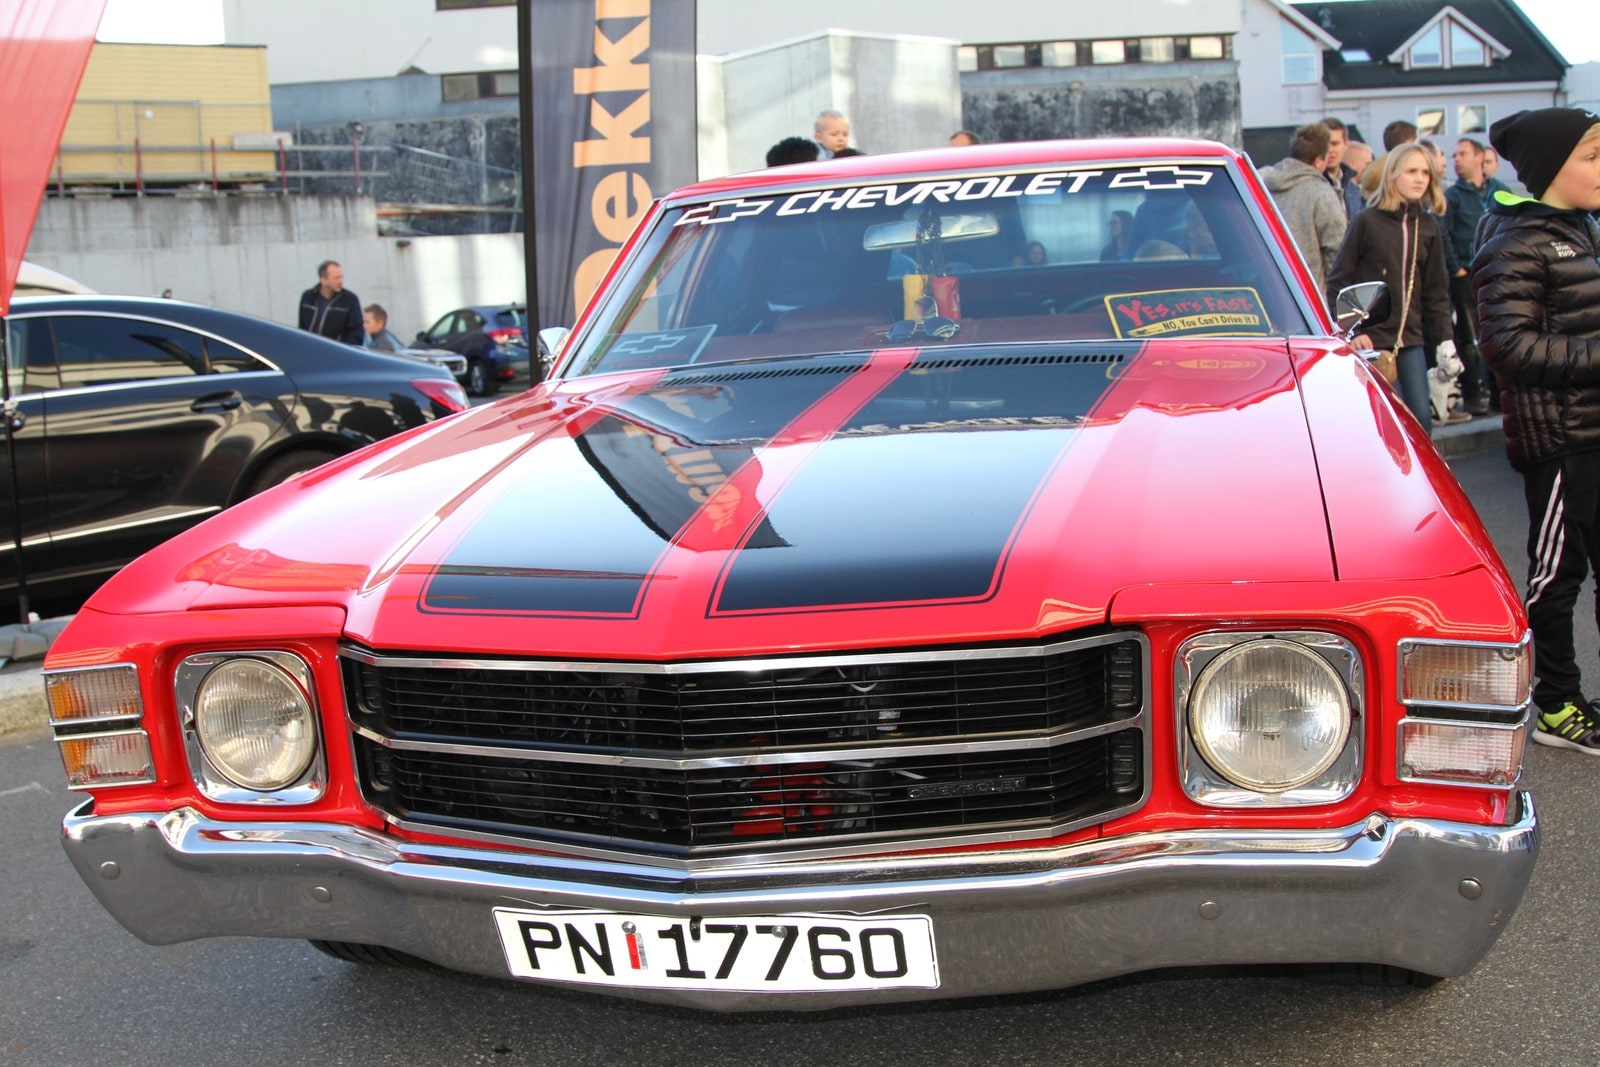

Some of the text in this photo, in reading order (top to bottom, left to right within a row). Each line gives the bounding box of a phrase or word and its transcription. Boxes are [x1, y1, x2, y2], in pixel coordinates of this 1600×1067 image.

[775, 170, 1104, 218] CHEVROLET
[1180, 319, 1196, 328] You
[1197, 316, 1219, 326] Can't
[1221, 315, 1243, 324] Drive
[517, 919, 908, 982] PN 17760
